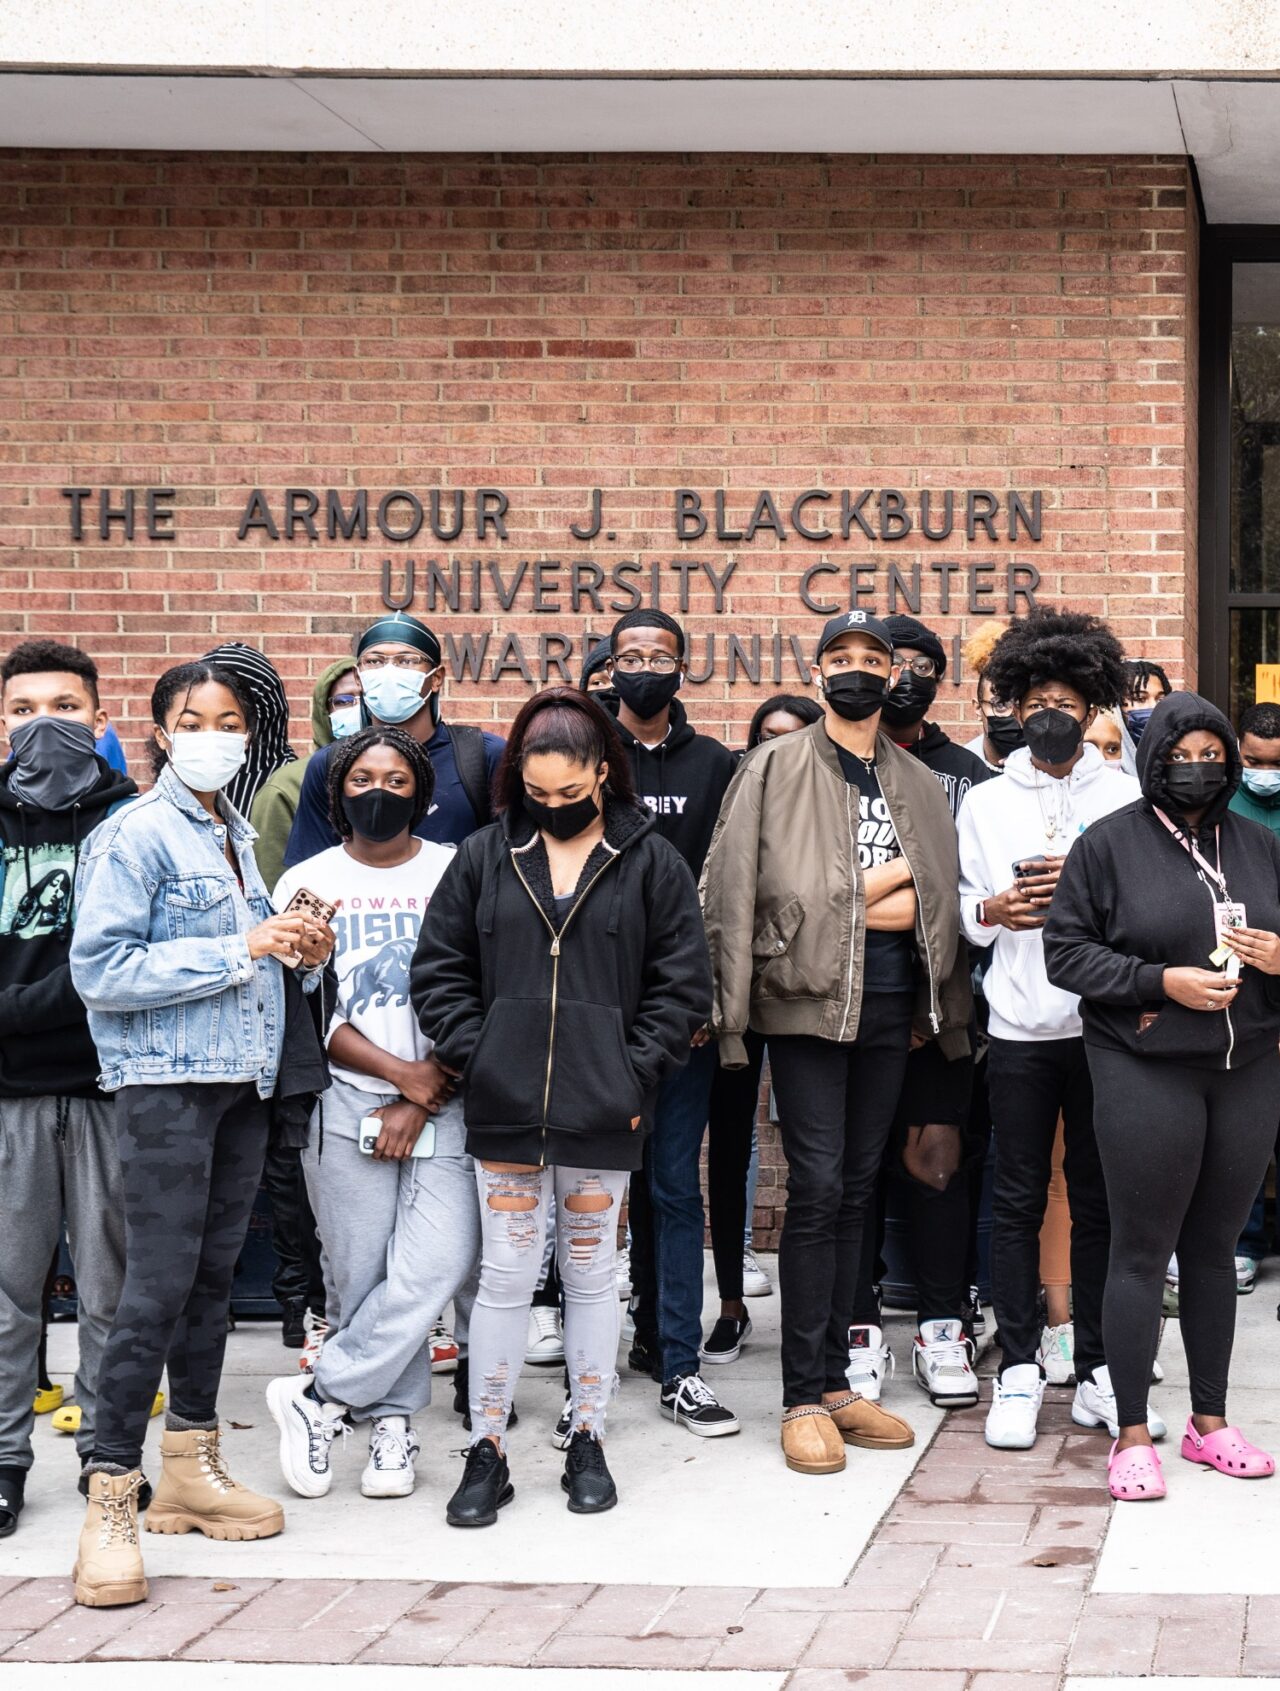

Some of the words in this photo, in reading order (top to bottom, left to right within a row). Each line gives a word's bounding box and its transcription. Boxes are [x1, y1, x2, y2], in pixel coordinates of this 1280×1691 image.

[61, 487, 176, 541] THE
[236, 487, 509, 541] ARMOUR
[569, 488, 616, 541] J.
[675, 488, 1043, 541] BLACKBURN
[381, 559, 738, 613] UNIVERSITY
[799, 562, 1041, 614] CENTER
[328, 911, 421, 959] BISO
